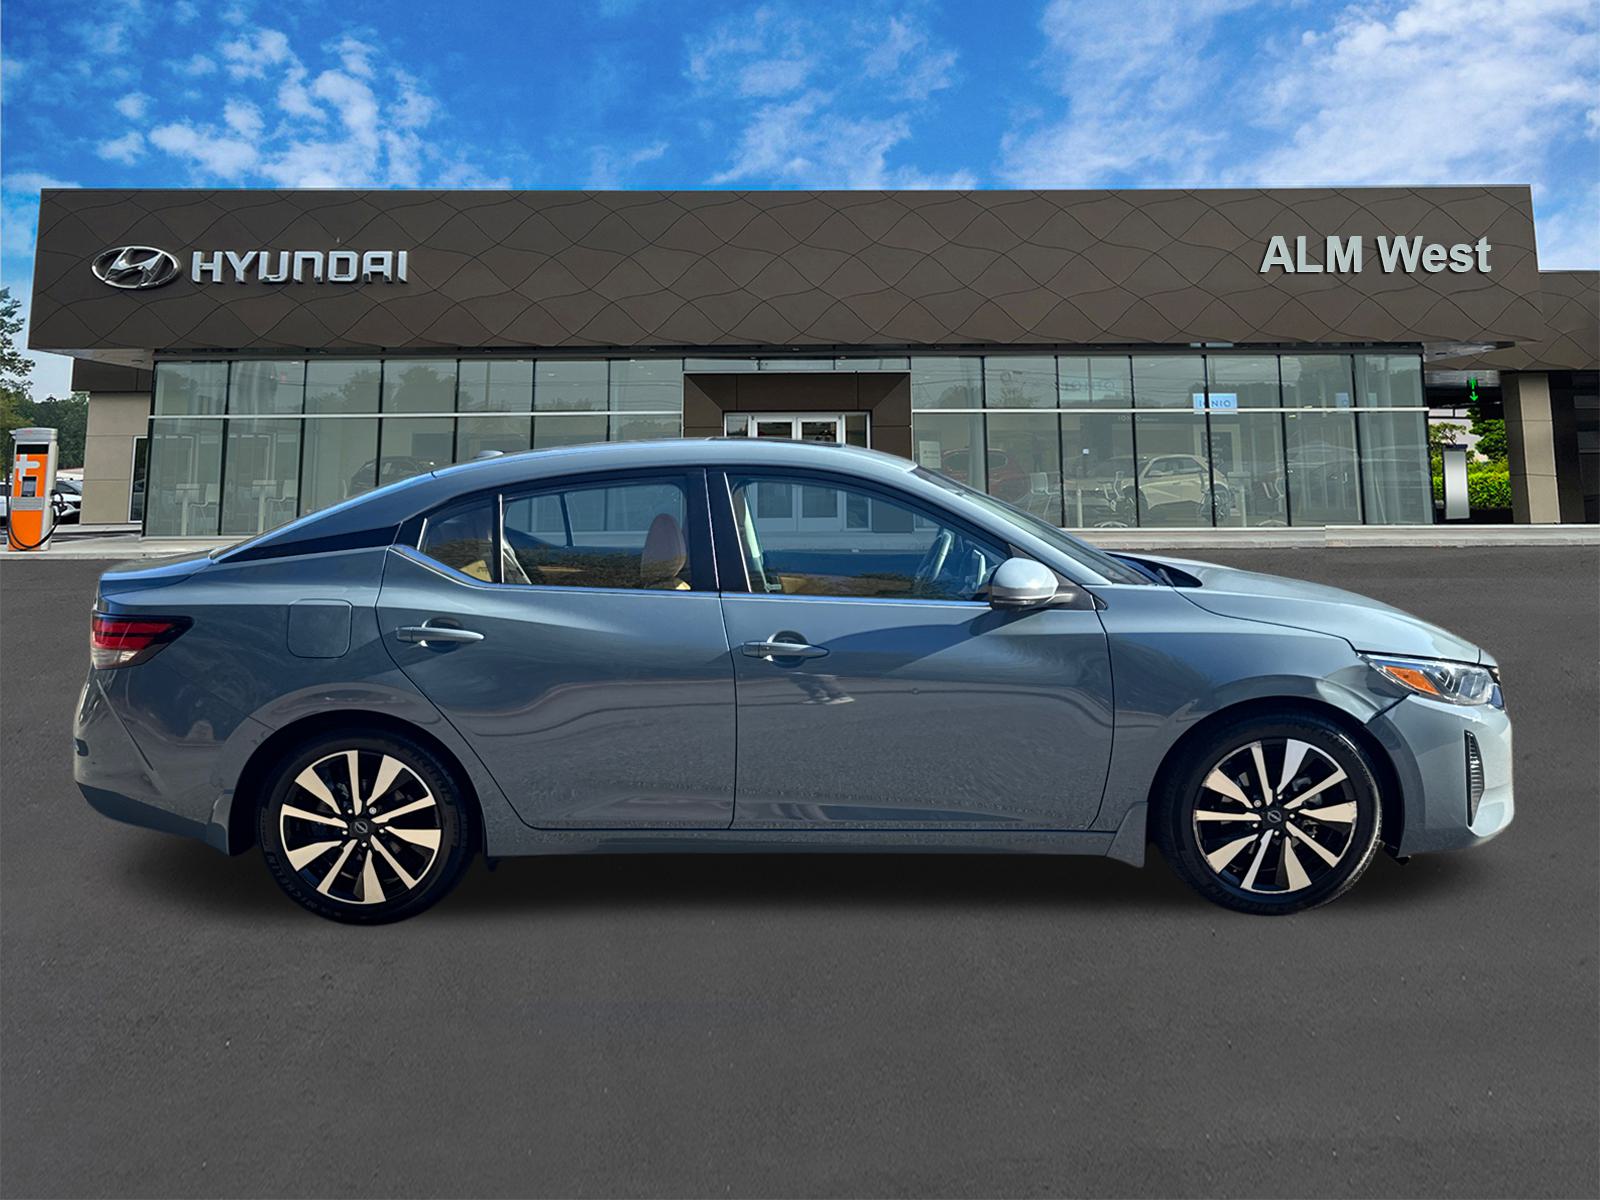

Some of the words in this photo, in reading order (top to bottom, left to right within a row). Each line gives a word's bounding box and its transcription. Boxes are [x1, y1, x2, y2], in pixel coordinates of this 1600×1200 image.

[192, 251, 408, 282] HYUNDAI
[1260, 235, 1363, 273] ALM
[1377, 235, 1492, 273] West
